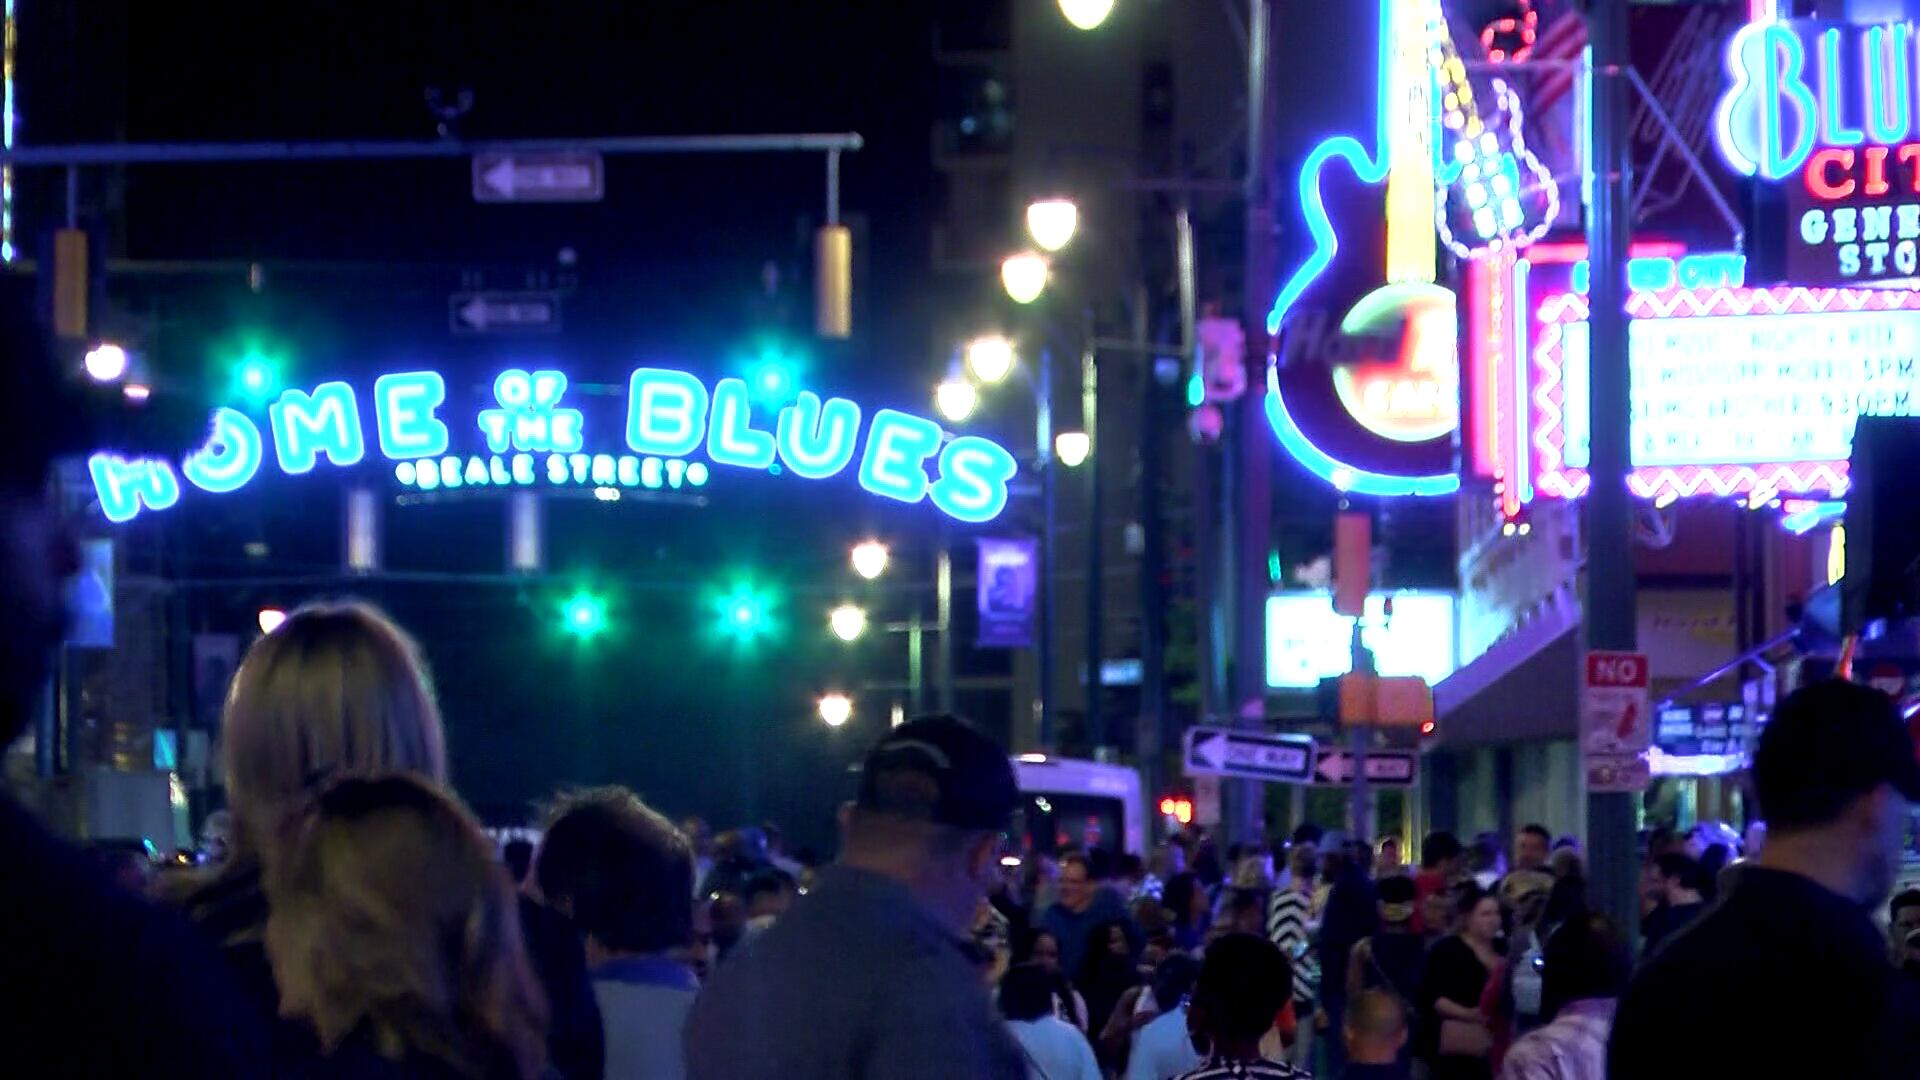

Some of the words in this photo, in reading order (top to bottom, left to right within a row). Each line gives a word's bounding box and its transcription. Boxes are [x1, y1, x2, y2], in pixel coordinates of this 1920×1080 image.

[494, 368, 568, 410] OF
[88, 370, 449, 522] HOME
[479, 408, 584, 454] THE
[626, 367, 1018, 523] BLUES
[415, 453, 536, 490] BEALE
[546, 453, 688, 490] STREET
[1595, 658, 1639, 684] NO
